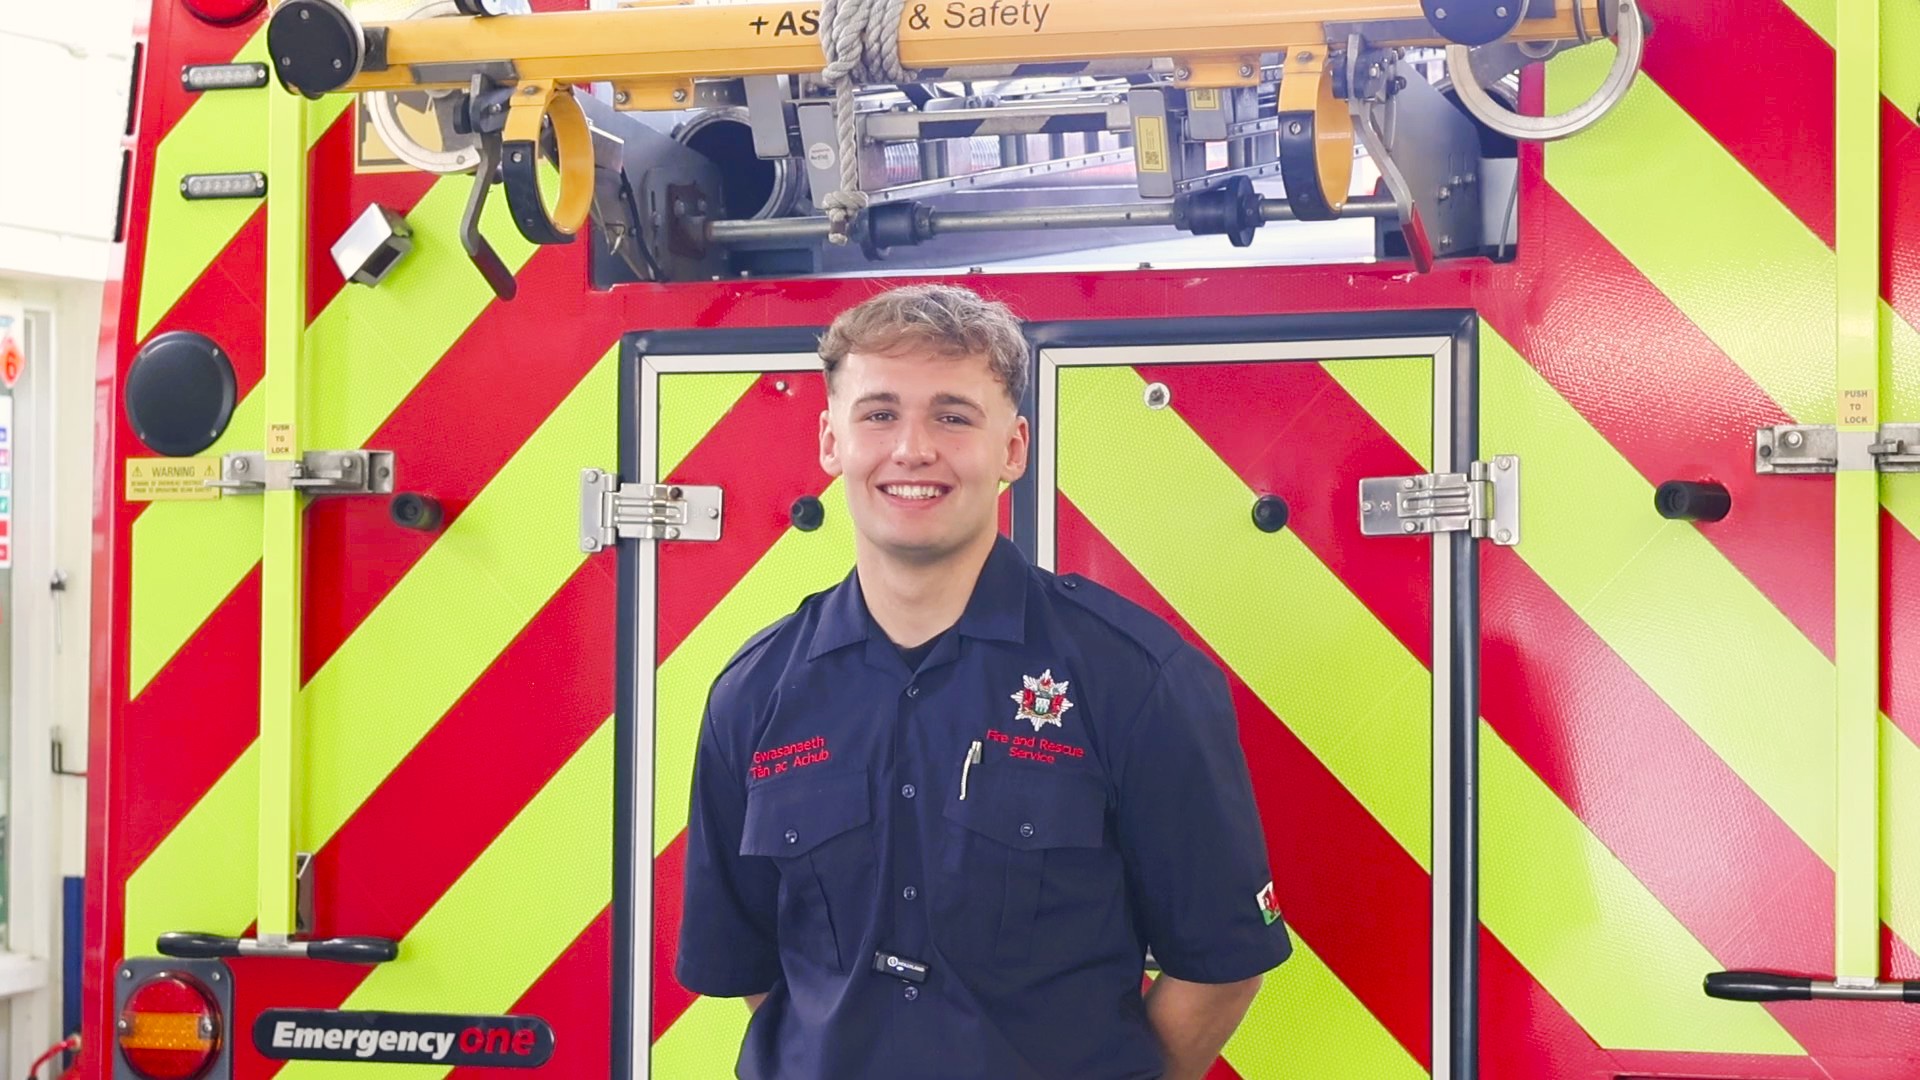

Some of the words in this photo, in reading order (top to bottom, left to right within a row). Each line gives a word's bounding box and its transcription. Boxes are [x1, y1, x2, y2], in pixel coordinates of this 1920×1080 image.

[908, 3, 931, 31] &
[943, 0, 1050, 33] Safety
[6, 350, 17, 381] 6
[1844, 389, 1868, 398] PUSH
[1849, 403, 1862, 411] TO
[1844, 416, 1868, 424] LOCK
[271, 446, 290, 454] LOCK
[151, 466, 195, 477] WARNING
[752, 735, 825, 764] Gwasanaeth
[986, 728, 1009, 744] Fire
[1012, 735, 1036, 748] and
[1039, 738, 1084, 758] Rescue
[774, 760, 788, 774] ac
[792, 747, 830, 768] Achub
[1008, 746, 1055, 764] Service
[271, 1020, 456, 1060] Emergency
[458, 1026, 536, 1055] one
